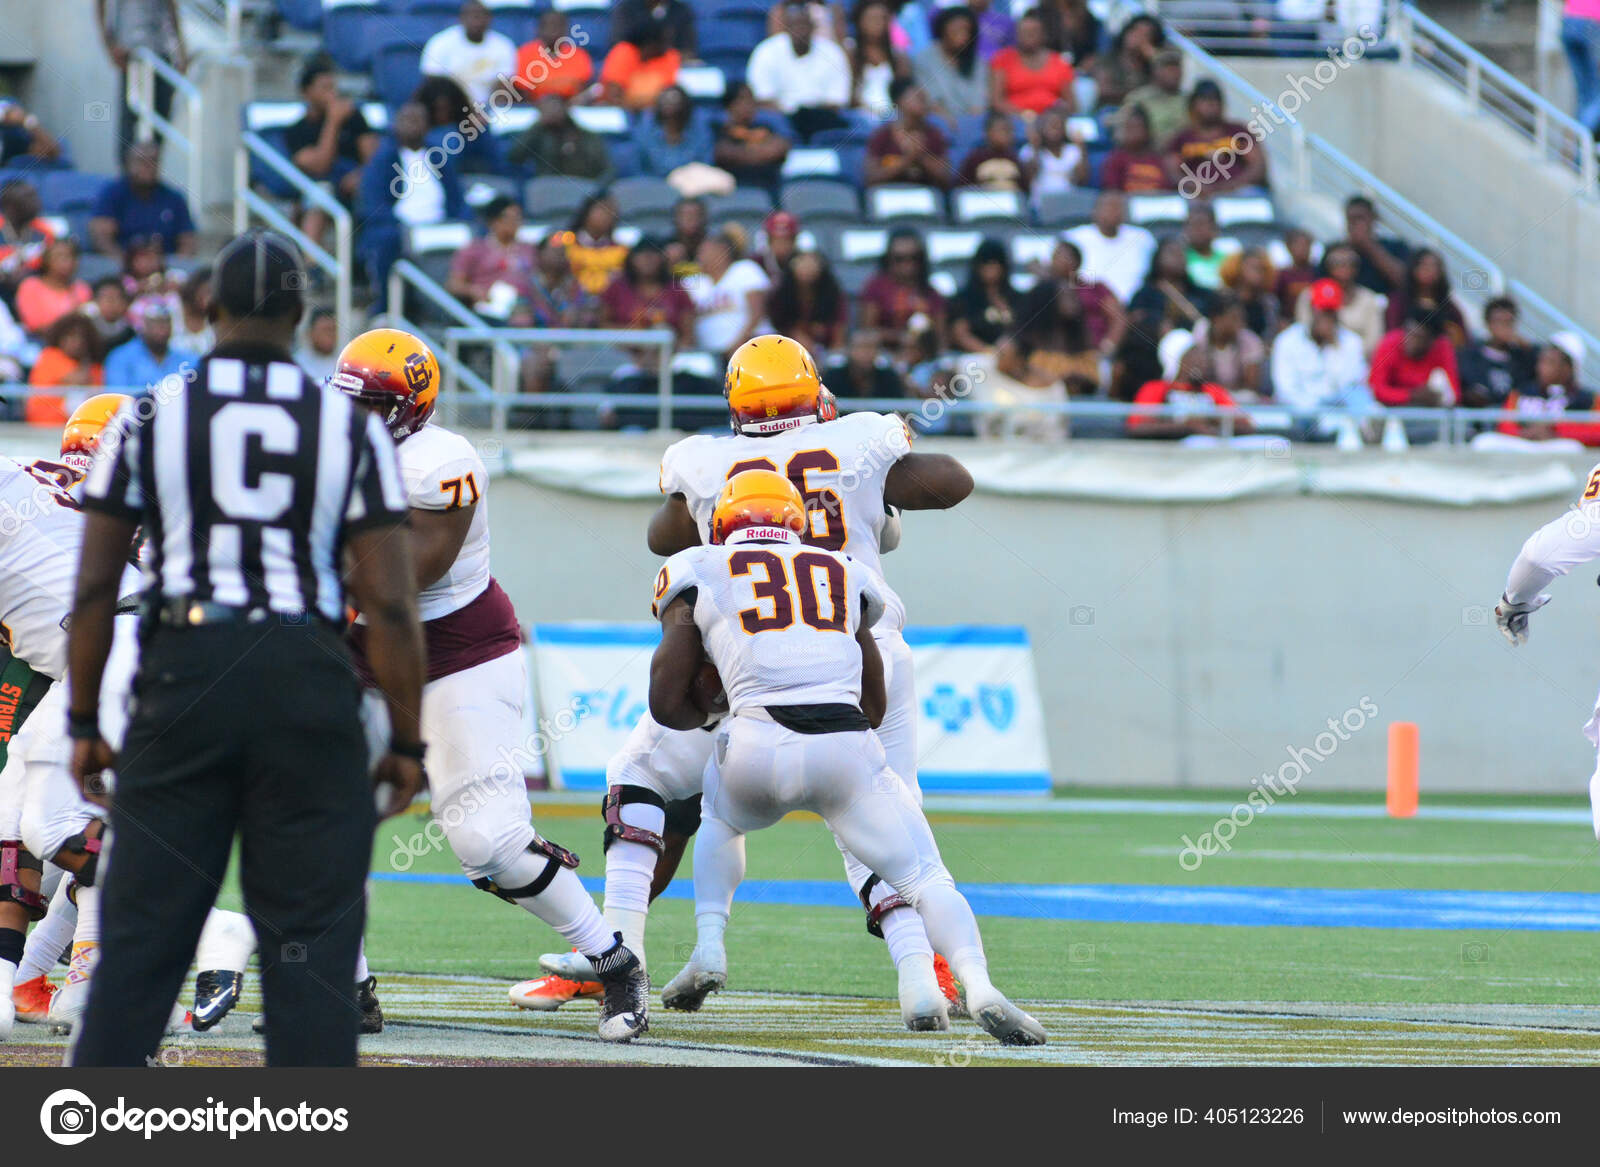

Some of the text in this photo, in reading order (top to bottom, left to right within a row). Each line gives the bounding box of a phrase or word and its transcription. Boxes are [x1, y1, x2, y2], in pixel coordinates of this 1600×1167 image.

[759, 418, 801, 432] Riddell
[209, 400, 300, 521] C
[440, 471, 481, 511] 71
[746, 528, 788, 541] Riddell
[728, 550, 849, 636] 30
[0, 682, 22, 743] STRIKE
